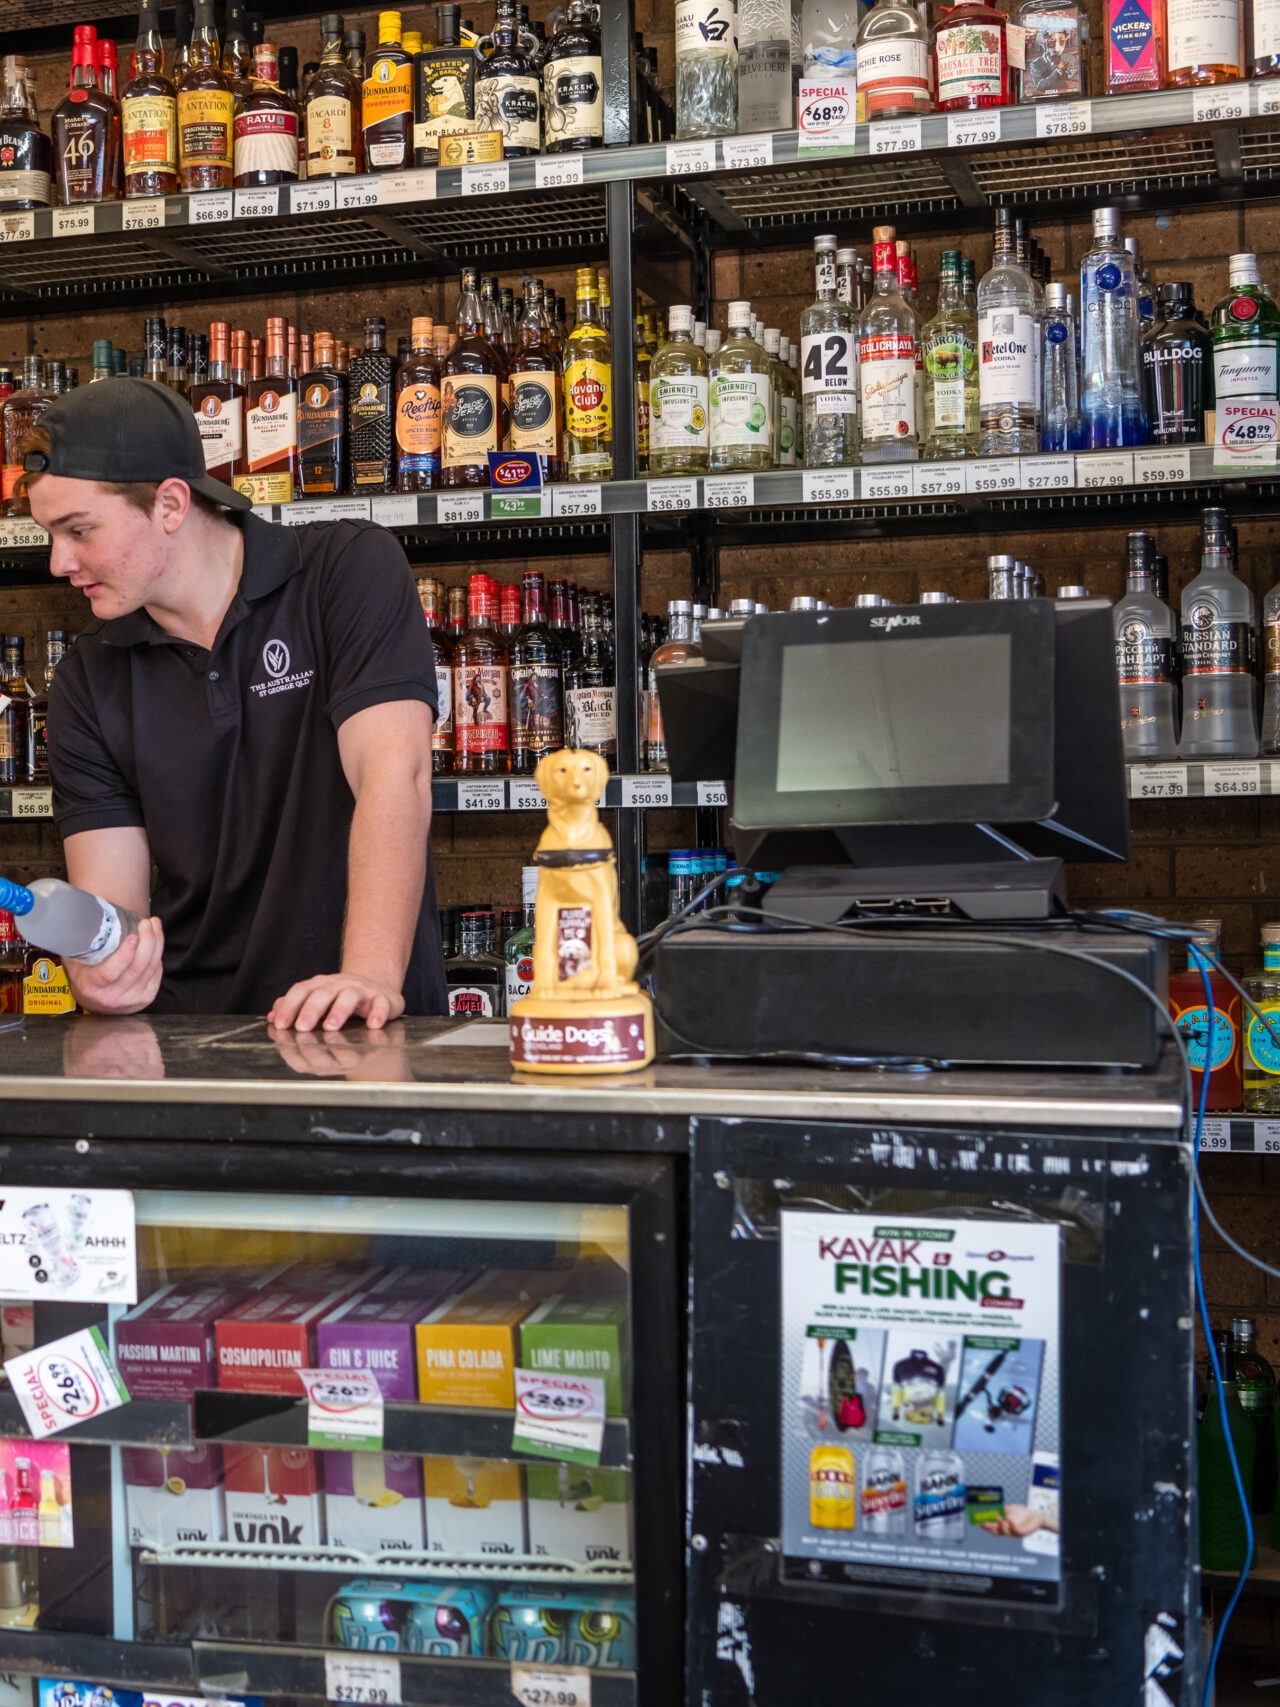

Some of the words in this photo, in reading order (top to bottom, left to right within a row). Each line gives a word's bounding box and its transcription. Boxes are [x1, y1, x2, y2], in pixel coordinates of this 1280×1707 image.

[1112, 22, 1151, 33] VICKERS
[879, 53, 902, 63] ROSE
[940, 58, 974, 71] SAUSAGE
[978, 57, 998, 67] TREE
[431, 60, 463, 69] RESTED
[740, 62, 788, 76] BELVEDERE
[362, 83, 410, 99] BUNDABERG
[558, 83, 593, 94] KRAKEN
[801, 87, 848, 97] SPECIAL
[366, 100, 405, 108] OVERPROOF
[247, 114, 275, 124] RATU
[310, 109, 346, 119] BACARDI
[1197, 108, 1242, 120] $60.99
[1046, 122, 1086, 134] $78.99
[63, 129, 94, 165] 46
[730, 156, 766, 167] $73.99
[470, 181, 506, 193] $65.99
[344, 195, 377, 206] $71.99
[240, 205, 273, 215] $68.99
[861, 339, 913, 354] STOLICHNAYA
[982, 341, 1008, 364] Ketel
[1009, 342, 1027, 354] One
[804, 335, 848, 381] 42
[1143, 348, 1202, 363] BULLDOG
[1219, 364, 1271, 379] Tanqueray
[825, 377, 848, 386] BELOW
[569, 384, 606, 395] Havana
[659, 386, 695, 397] SMIRNOFF
[575, 394, 598, 405] Club
[297, 410, 340, 422] BUNDABERG
[1225, 407, 1276, 416] SPECIAL
[251, 412, 288, 424] BUNDABERG
[1142, 469, 1184, 481] $59.99
[561, 503, 597, 514] $57.99
[870, 613, 922, 631] SENOR
[1184, 631, 1230, 641] RUSSIAN
[1183, 641, 1237, 651] STANDARD
[512, 667, 533, 679] Captain
[533, 667, 558, 678] Morgan
[250, 683, 266, 692] THE
[267, 670, 314, 687] AUSTRALIAN
[268, 683, 294, 695] GEORGE
[295, 679, 309, 687] QLD
[582, 700, 612, 712] Black
[1215, 782, 1256, 793] $64.99
[465, 799, 500, 808] $41.99
[631, 793, 668, 805] $50.99
[18, 804, 49, 814] $56.99
[24, 983, 69, 995] BUNDABERG
[450, 1001, 485, 1011] SAMEDI
[521, 1026, 563, 1042] Guide
[85, 1235, 126, 1249] AHHH
[819, 1235, 921, 1265] KAYAK
[835, 1262, 1011, 1300] FISHING
[118, 1343, 155, 1362] PASSION
[157, 1345, 201, 1363] MARTINI
[220, 1346, 302, 1367] COSMOPOLITAN
[328, 1348, 350, 1367] GIN
[366, 1349, 399, 1369] JUICE
[427, 1349, 454, 1368] PINA
[458, 1349, 504, 1369] COLADA
[531, 1348, 559, 1368] LIME
[564, 1349, 610, 1370] MOJITO
[521, 1377, 592, 1393] SPECIAL
[24, 1364, 57, 1429] SPECIAL
[336, 1686, 388, 1702] $27.99
